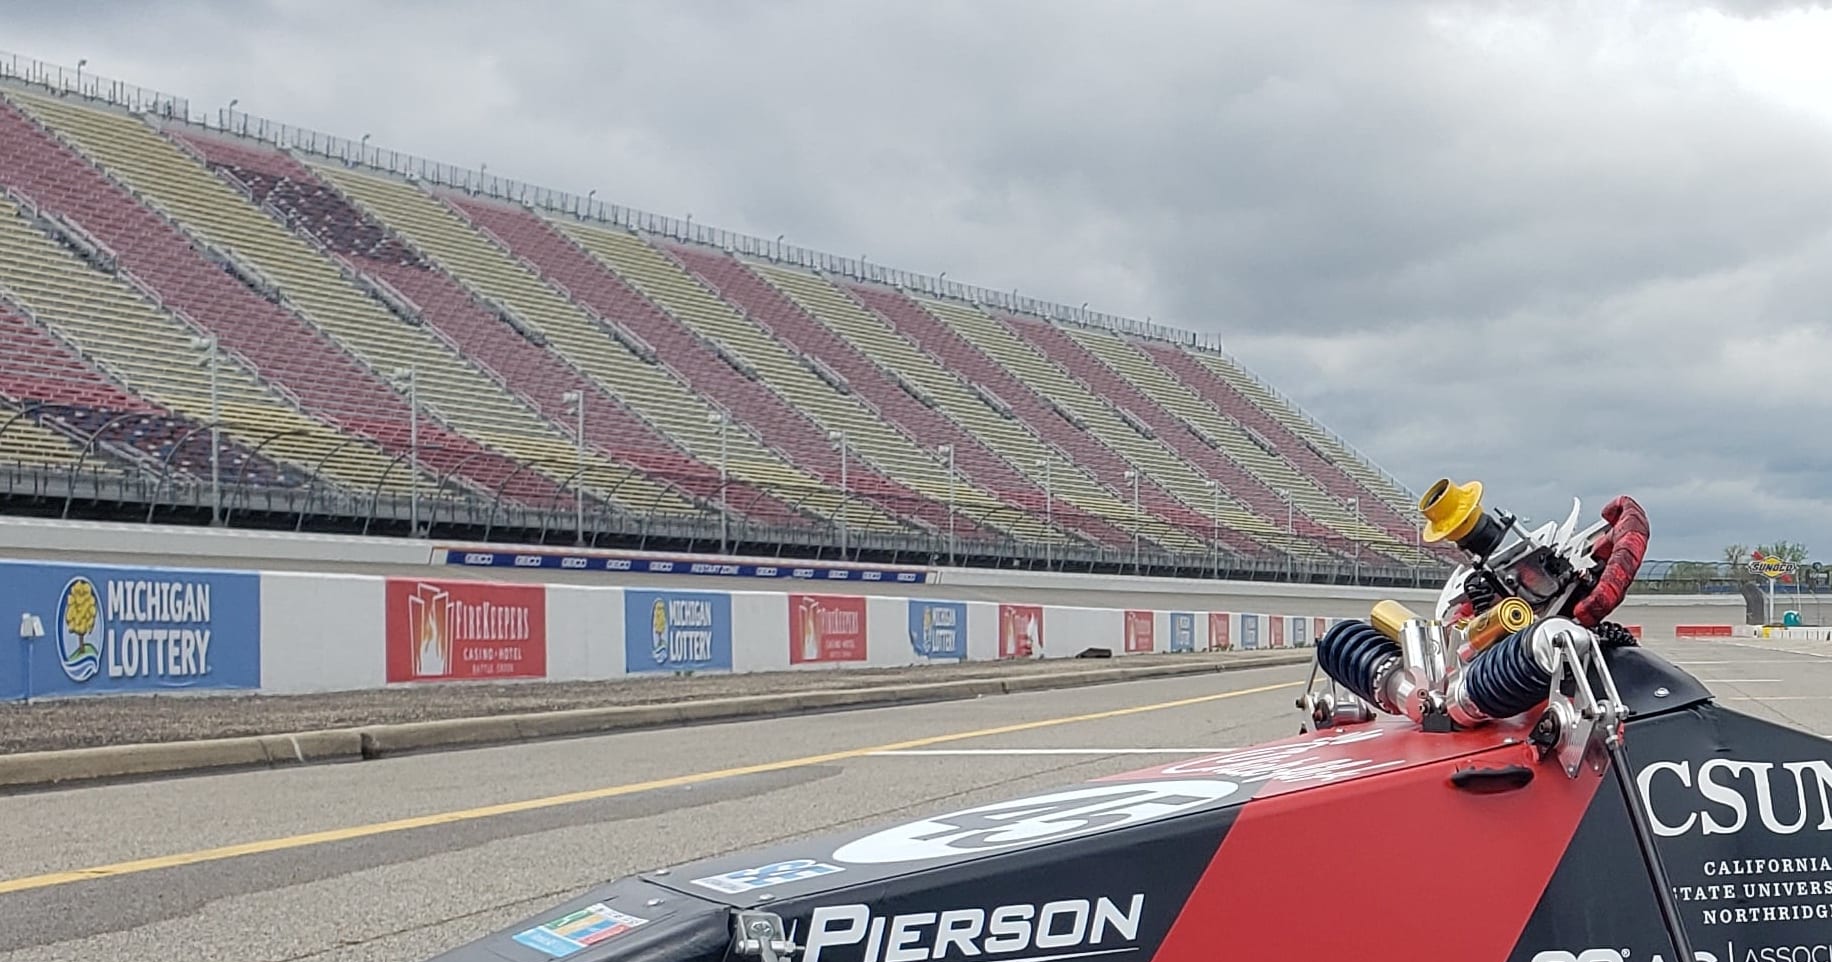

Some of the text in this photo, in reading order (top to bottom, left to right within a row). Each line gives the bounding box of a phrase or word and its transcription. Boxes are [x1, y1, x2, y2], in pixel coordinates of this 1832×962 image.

[1752, 562, 1793, 573] SUNOCO
[107, 580, 210, 622] MICHIGAN
[668, 600, 712, 626] MICHIGAN
[107, 628, 212, 677] LOTTERY
[669, 631, 713, 661] LOTTERY
[908, 788, 1211, 850] 45
[1703, 857, 1832, 877] CALIFORNIA
[1673, 885, 1736, 902] TATE
